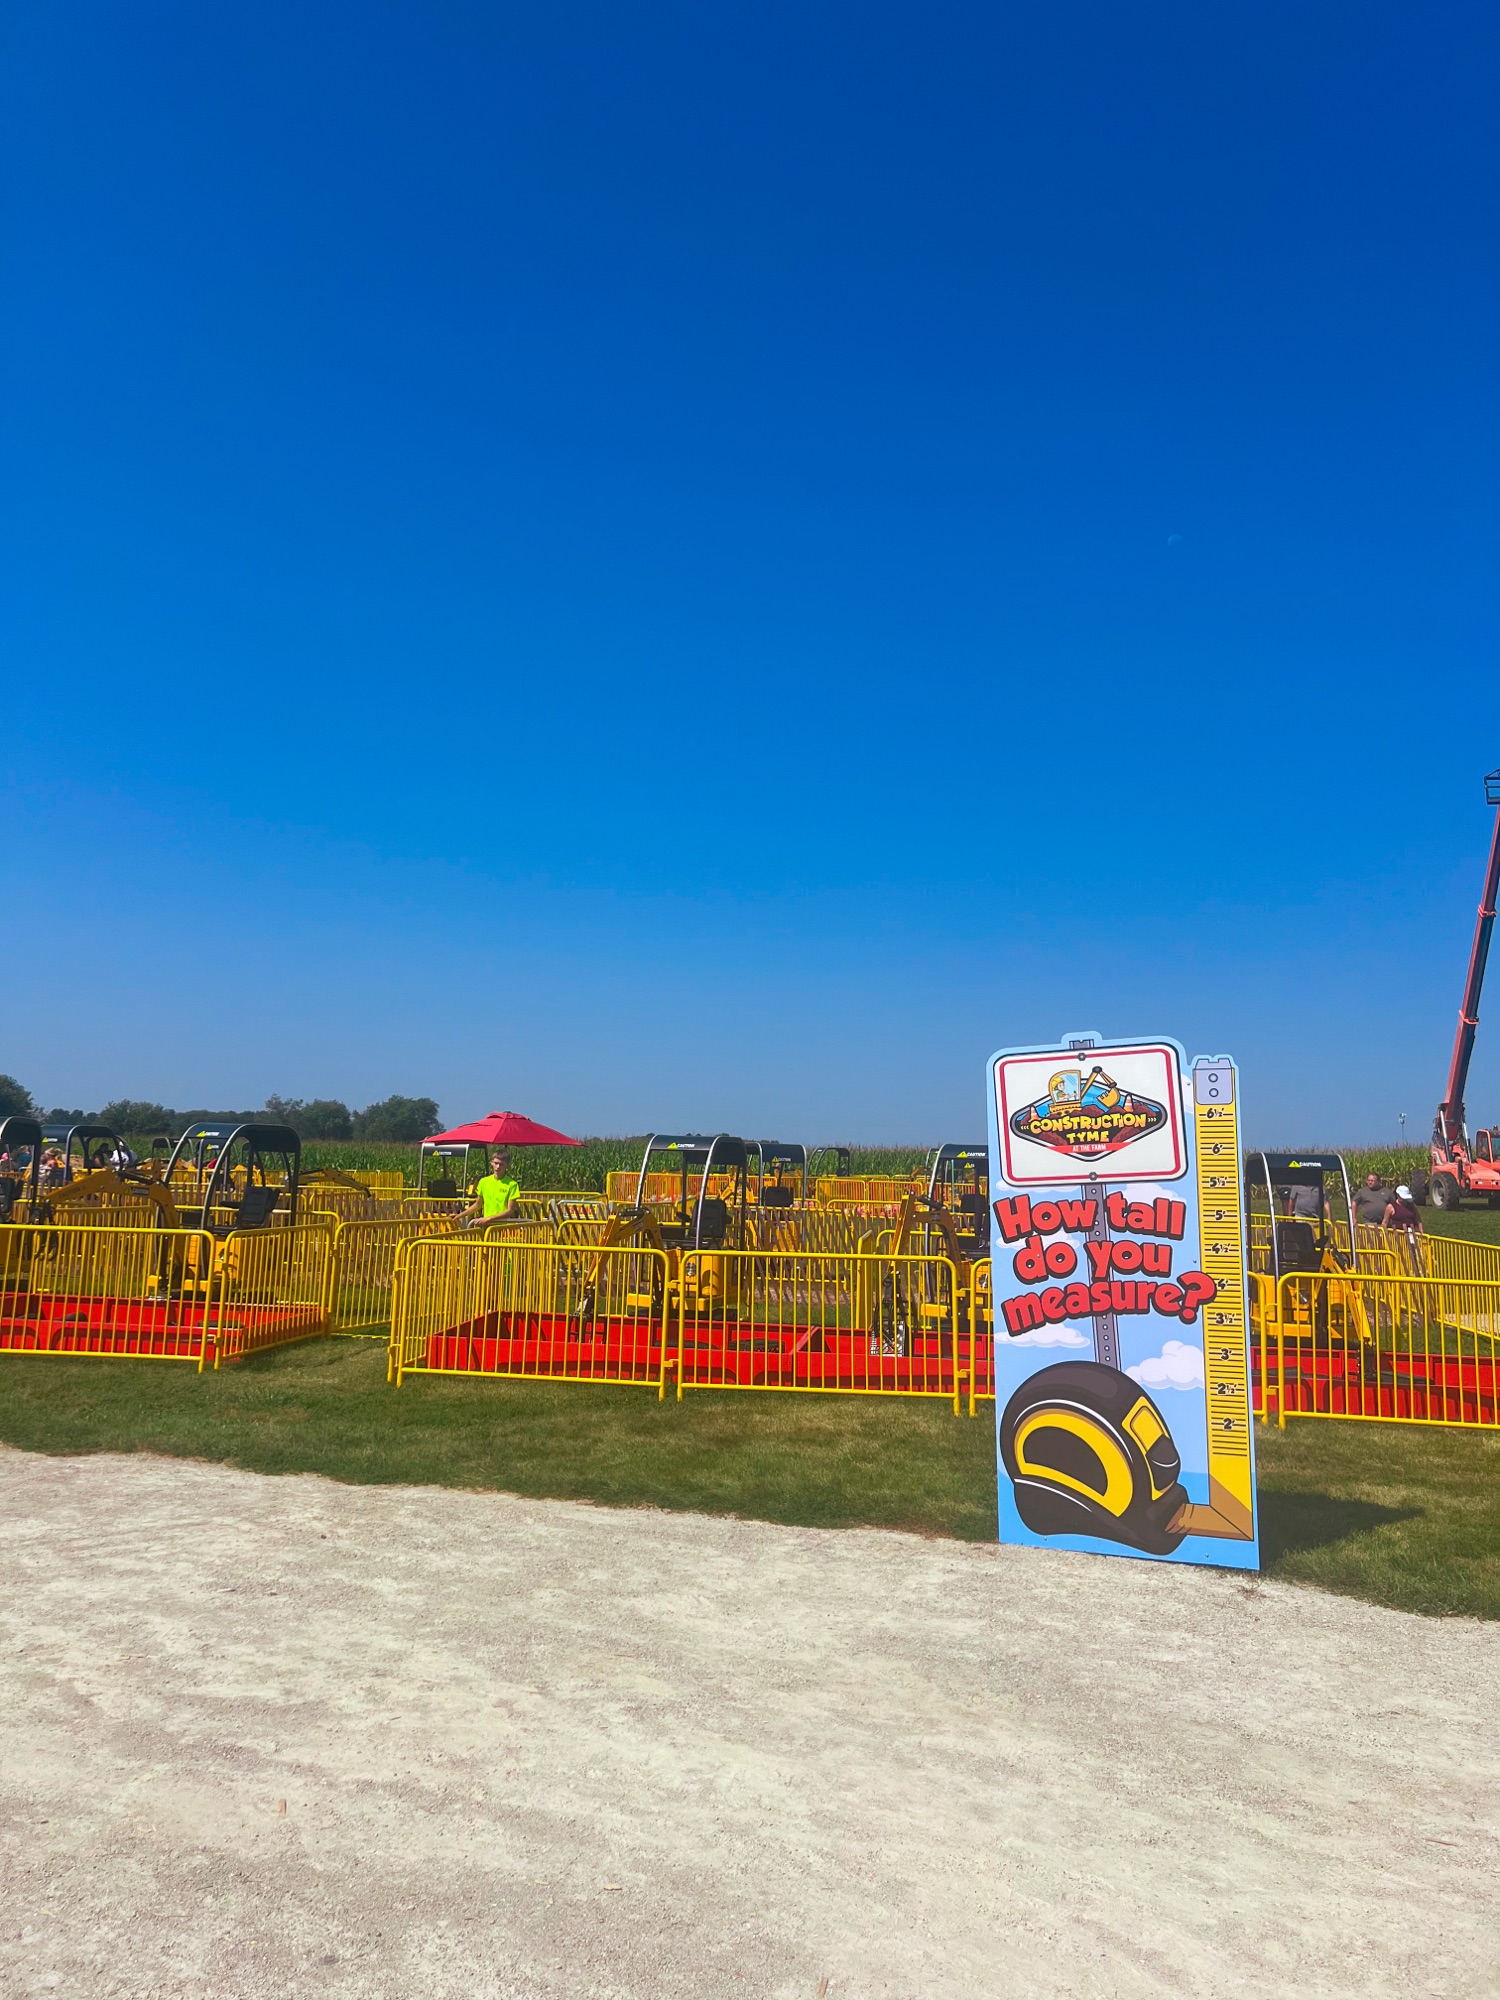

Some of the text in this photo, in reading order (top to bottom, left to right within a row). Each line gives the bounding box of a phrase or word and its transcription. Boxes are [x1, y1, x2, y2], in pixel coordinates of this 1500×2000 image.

[1030, 1112, 1146, 1134] CONSTRUCTION
[1066, 1131, 1110, 1144] TYME
[995, 1191, 1185, 1242] How tall
[1014, 1235, 1172, 1284] do you
[1002, 1270, 1216, 1336] measure?
